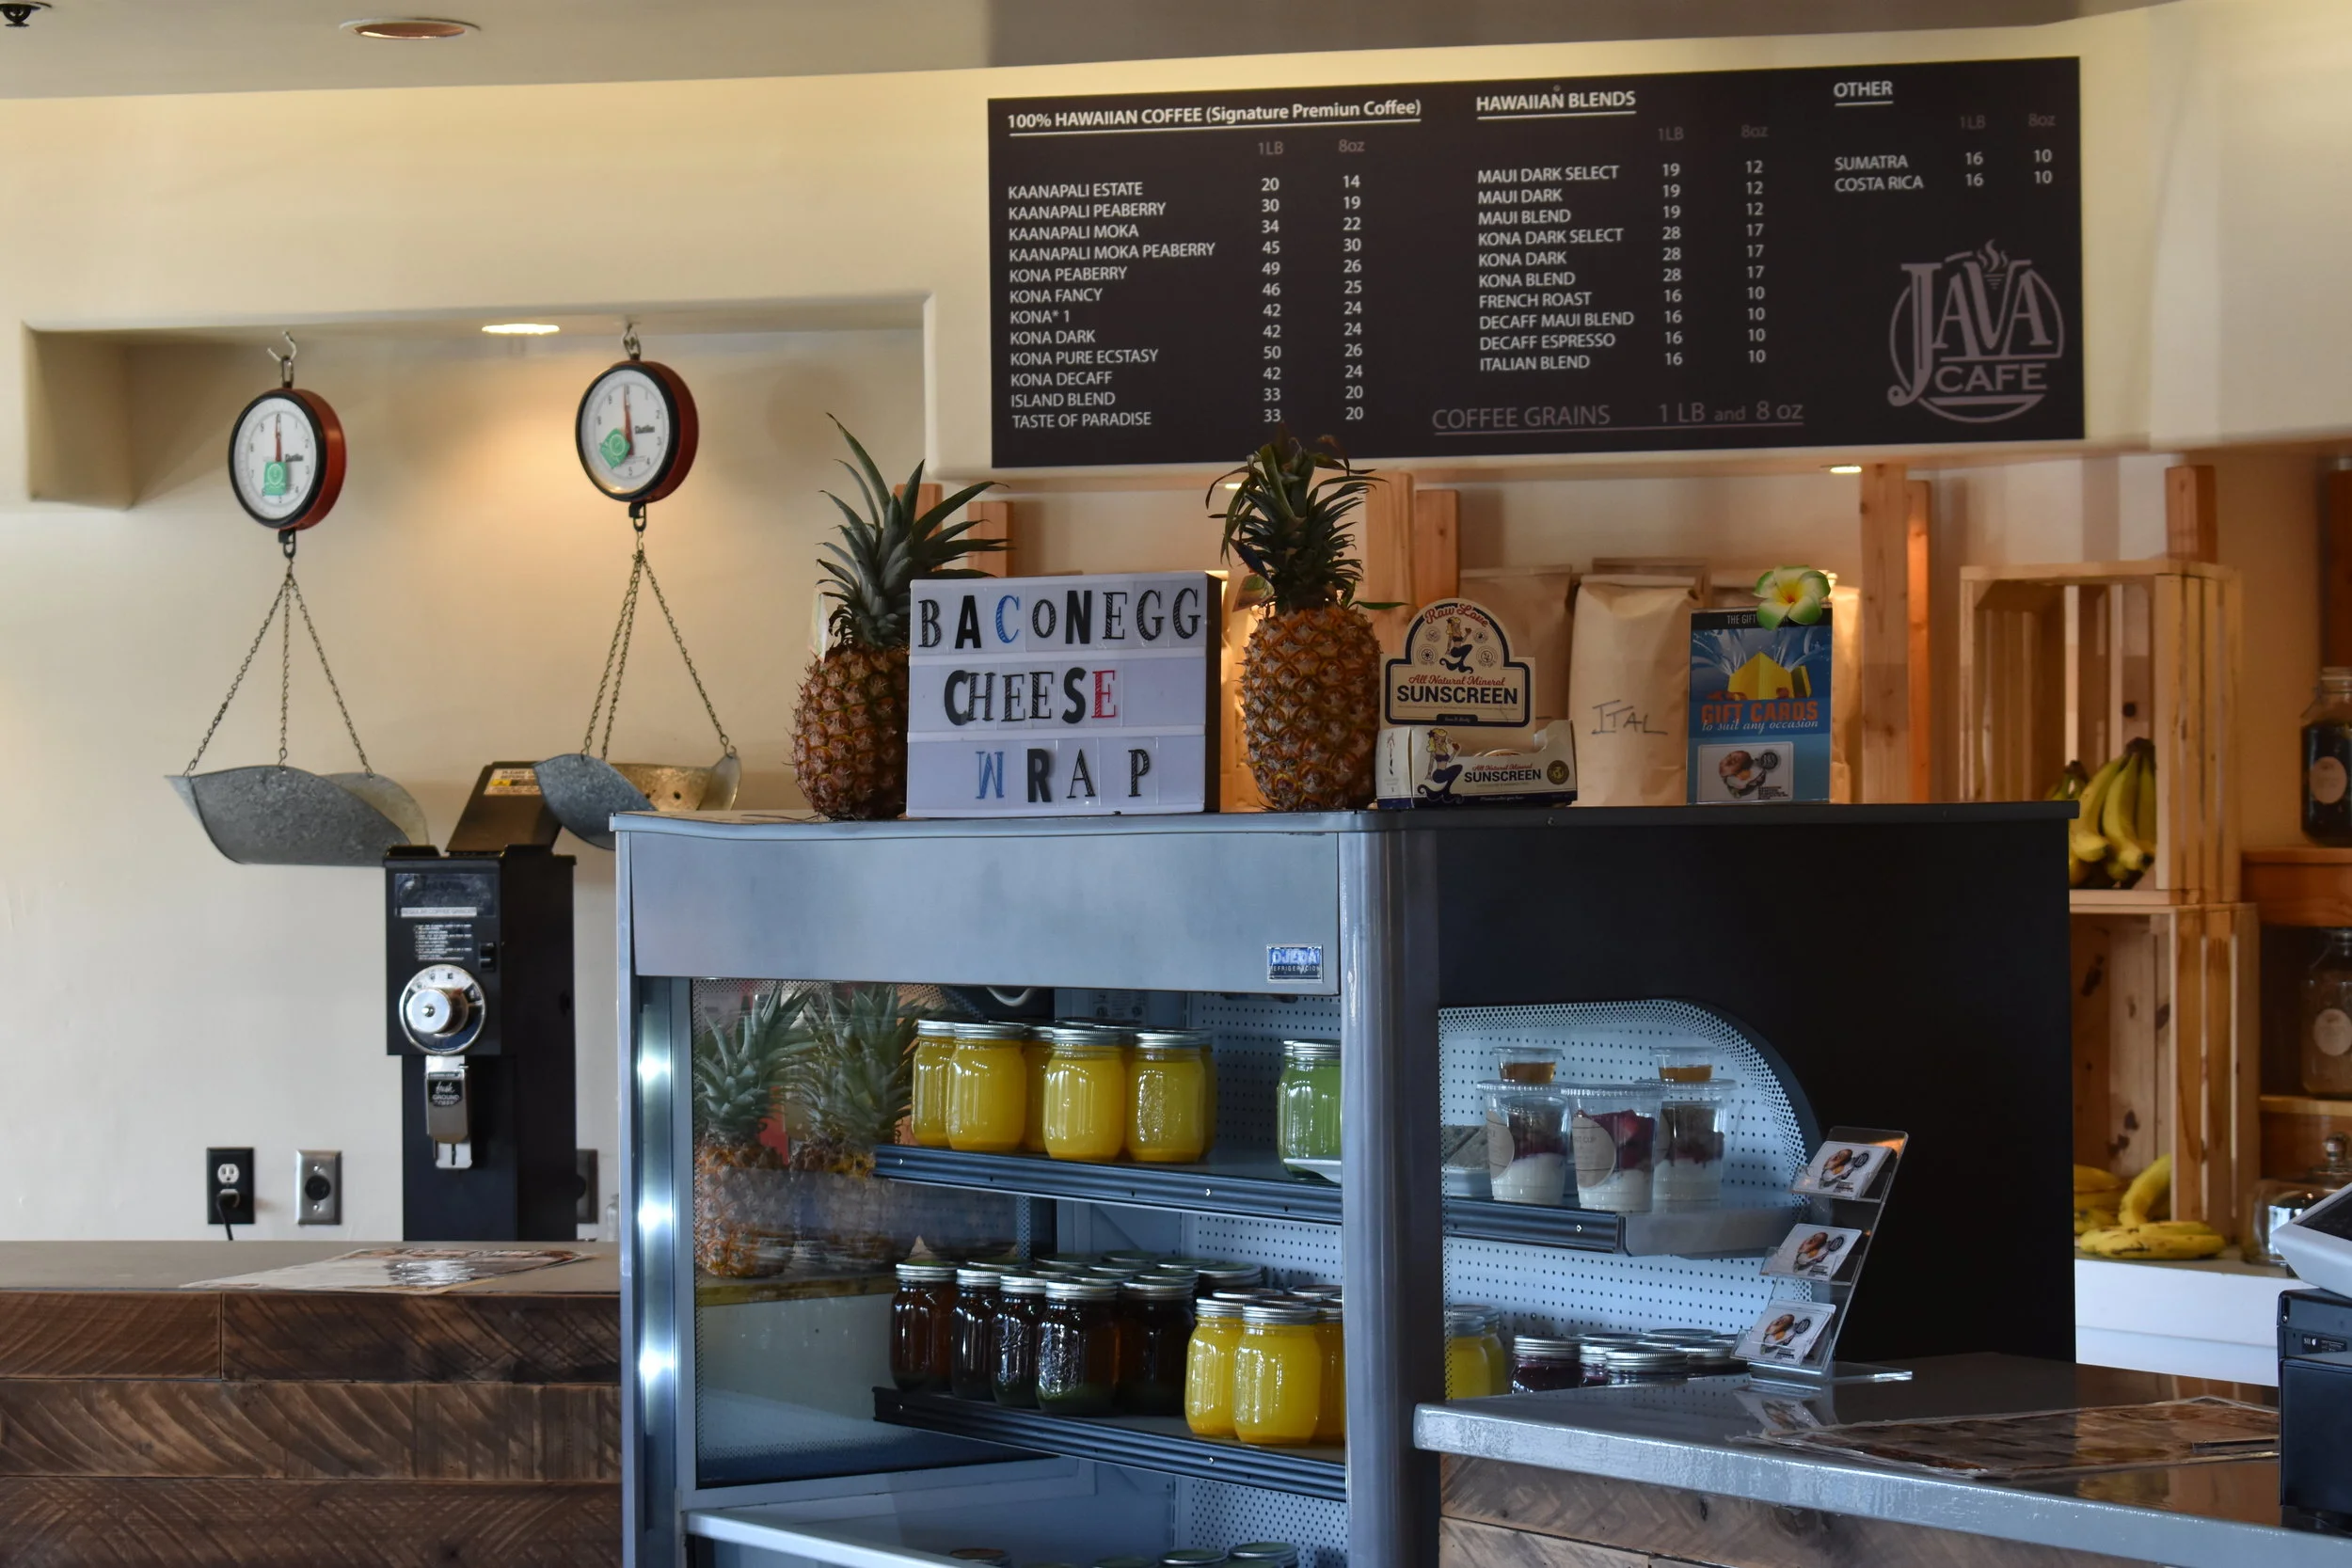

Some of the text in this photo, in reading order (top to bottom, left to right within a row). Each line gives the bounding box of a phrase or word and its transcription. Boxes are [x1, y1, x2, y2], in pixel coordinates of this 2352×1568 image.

[1834, 81, 1893, 98] OTHER
[1477, 91, 1635, 111] HAWAIIAN BLENDS
[1009, 114, 1052, 128] 100%
[1056, 110, 1137, 126] HAWAIIAN
[1141, 107, 1202, 123] COFFEE
[1206, 107, 1289, 124] (Signature
[1364, 100, 1421, 116] Coffee)
[2028, 114, 2056, 127] 8oz
[1961, 115, 1986, 130] 1LB
[1659, 126, 1684, 141] 1LB
[1741, 124, 1768, 138] 8oz
[1259, 141, 1283, 155] 1LB
[1339, 139, 1364, 152] 8oz
[1835, 155, 1908, 171] SUMATRA
[1966, 151, 1983, 165] 16
[2035, 150, 2052, 163] 10
[1663, 163, 1680, 176] 19
[1746, 160, 1762, 173] 12
[1343, 175, 1360, 188] 14
[1478, 166, 1619, 183] MAUI DARK SELECT
[1966, 173, 1983, 186] 16
[2035, 170, 2053, 183] 10
[1009, 182, 1142, 198] KAANAPALI ESTATE
[1262, 178, 1279, 191] 20
[1746, 182, 1763, 195] 12
[1835, 175, 1924, 192] COSTA RICA
[1478, 189, 1562, 204] MAUI DARK
[1663, 184, 1680, 198] 19
[1263, 198, 1279, 212] 30
[1344, 196, 1360, 209] 19
[1746, 202, 1763, 215] 12
[1009, 202, 1166, 220] KAANAPALI PEABERRY
[1479, 209, 1571, 225] MAUI BLEND
[1663, 205, 1680, 218] 19
[1263, 220, 1279, 233] 34
[1343, 217, 1360, 230] 22
[1746, 223, 1763, 236] 17
[1009, 224, 1138, 241] KAANAPALI MOKA
[1479, 229, 1624, 245] KONA DARK SELECT
[1662, 226, 1681, 240] 28
[1263, 241, 1279, 254] 45
[1343, 238, 1361, 251] 30
[1747, 245, 1764, 257] 17
[1009, 243, 1215, 261] KAANAPALI MOKA PEABERRY
[1479, 251, 1566, 267] KONA DARK
[1663, 247, 1681, 261] 28
[1262, 261, 1280, 275] 49
[1343, 260, 1361, 273] 26
[1748, 265, 1764, 278] 17
[1009, 266, 1127, 282] KONA PEABERRY
[1479, 272, 1575, 288] KONA BLEND
[1663, 268, 1681, 281] 28
[1263, 283, 1280, 296] 46
[1344, 280, 1361, 293] 25
[1748, 286, 1765, 299] 10
[1010, 288, 1103, 303] KONA FANCY
[1480, 292, 1592, 309] FRENCH ROAST
[1664, 289, 1681, 302] 16
[1263, 304, 1280, 317] 42
[1344, 301, 1361, 314] 24
[1748, 308, 1765, 321] 10
[1064, 310, 1069, 323] 1
[1480, 312, 1634, 329] DECAFF MAUI BLEND
[1665, 309, 1682, 324] 16
[1263, 325, 1280, 338] 42
[1344, 323, 1361, 336] 24
[1749, 328, 1766, 341] 10
[1887, 259, 2053, 407] JAVA
[1010, 330, 1095, 345] KONA DARK
[1480, 333, 1615, 350] DECAFF ESPRESSO
[1665, 331, 1683, 344] 16
[1264, 346, 1281, 359] 50
[1345, 343, 1362, 356] 26
[1749, 350, 1766, 363] 10
[1010, 349, 1158, 366] KONA PURE ECSTASY
[1481, 356, 1590, 371] ITALIAN BLEND
[1666, 353, 1682, 365] 16
[1263, 367, 1280, 380] 42
[1345, 365, 1362, 378] 24
[1935, 363, 2048, 393] CAFE
[1011, 372, 1112, 387] KONA DECAFF
[1011, 392, 1115, 407] ISLAND BLEND
[1264, 388, 1280, 401] 33
[1345, 386, 1363, 399] 20
[1264, 409, 1280, 422] 33
[1345, 406, 1363, 420] 20
[1433, 404, 1610, 429] COFFEE GRAINS
[1660, 401, 1803, 422] 1 LB and 8 oz
[1012, 412, 1152, 428] TASTE OF PARADISE
[1727, 613, 1756, 625] THE GIFT
[1408, 673, 1506, 687] All Natural Mineral
[944, 667, 1117, 726] CHEESE
[1397, 685, 1518, 705] SUNSCREEN
[1701, 700, 1819, 724] GIFT CARDS
[1702, 719, 1819, 736] to suit any occasion
[976, 749, 1151, 803] WRAP
[1464, 768, 1541, 783] SUNSCREEN
